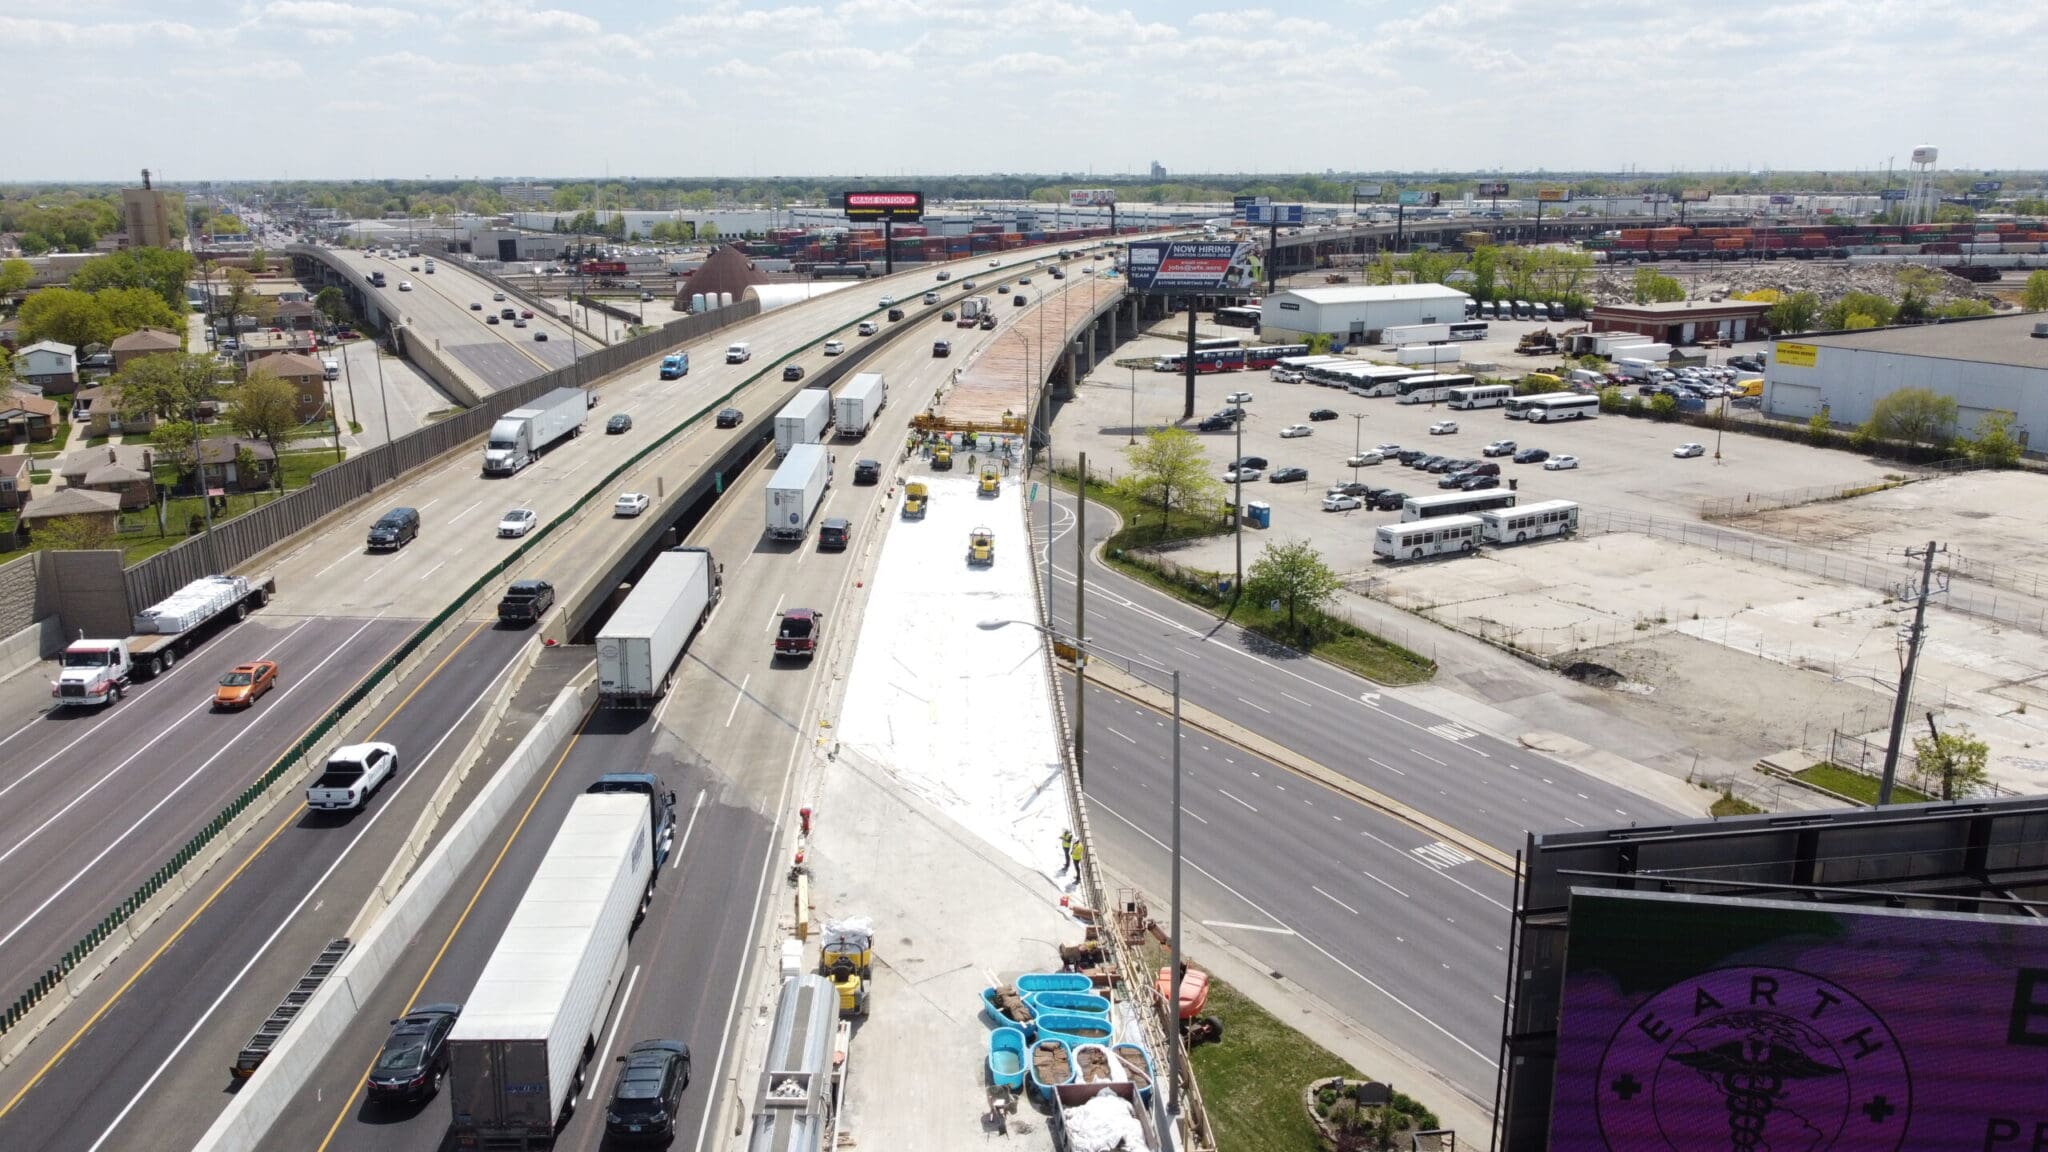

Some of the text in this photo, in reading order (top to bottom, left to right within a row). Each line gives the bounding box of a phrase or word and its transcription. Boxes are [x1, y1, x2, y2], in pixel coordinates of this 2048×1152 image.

[1173, 245, 1231, 253] NOW HIRING
[1638, 975, 1882, 1060] EARTH
